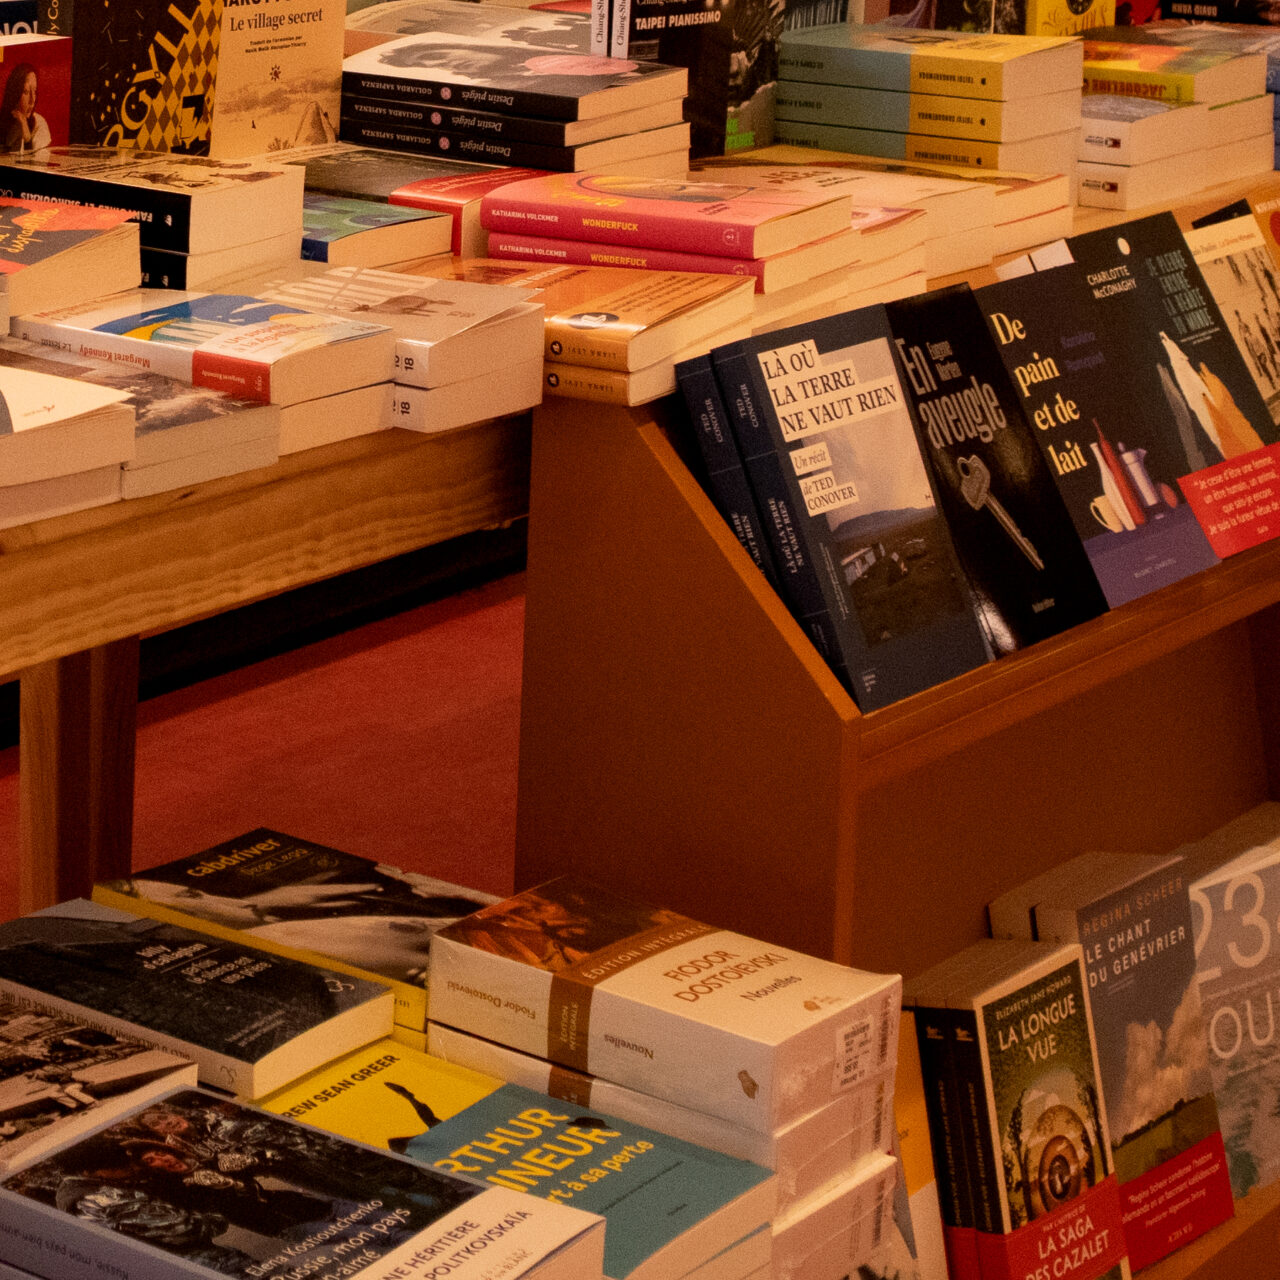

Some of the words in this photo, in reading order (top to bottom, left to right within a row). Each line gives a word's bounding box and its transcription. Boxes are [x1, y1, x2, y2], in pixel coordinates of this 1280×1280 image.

[230, 17, 245, 32] Le
[247, 12, 285, 32] village
[287, 8, 323, 24] secret
[635, 16, 666, 31] TAIPEI
[670, 10, 721, 27] PIANISSIMO
[492, 209, 525, 219] KATHARINA
[527, 213, 559, 222] VOLCKMER
[582, 218, 638, 231] WONDERFUCK
[1087, 266, 1130, 288] CHARLOTTE
[1091, 277, 1137, 300] McCONAGHY
[990, 311, 1027, 346] De
[763, 352, 789, 380] LÀ
[790, 344, 815, 373] OÙ
[895, 339, 937, 395] En
[1014, 352, 1060, 397] pain
[772, 385, 797, 407] LA
[798, 368, 855, 399] TERRE
[781, 412, 807, 435] NE
[808, 398, 854, 425] VAUT
[856, 385, 898, 412] RIEN
[919, 376, 1006, 449] aveugle
[1034, 402, 1056, 431] et
[1055, 394, 1080, 424] de
[1048, 441, 1088, 476] lait
[186, 838, 282, 878] cabdriver
[1086, 943, 1098, 965] LE
[1101, 918, 1151, 953] CHANT
[1089, 968, 1109, 989] DU
[1112, 925, 1186, 977] GENÉVRIER
[663, 949, 740, 982] FIODOR
[673, 952, 789, 1002] DOSTOÏEVSKI
[740, 975, 802, 1001] Nouvelles
[998, 1029, 1019, 1052] LA
[1021, 994, 1078, 1041] LONGUE
[1026, 1039, 1058, 1063] VUE
[314, 1081, 354, 1105] SEAN
[351, 1055, 401, 1091] GREER
